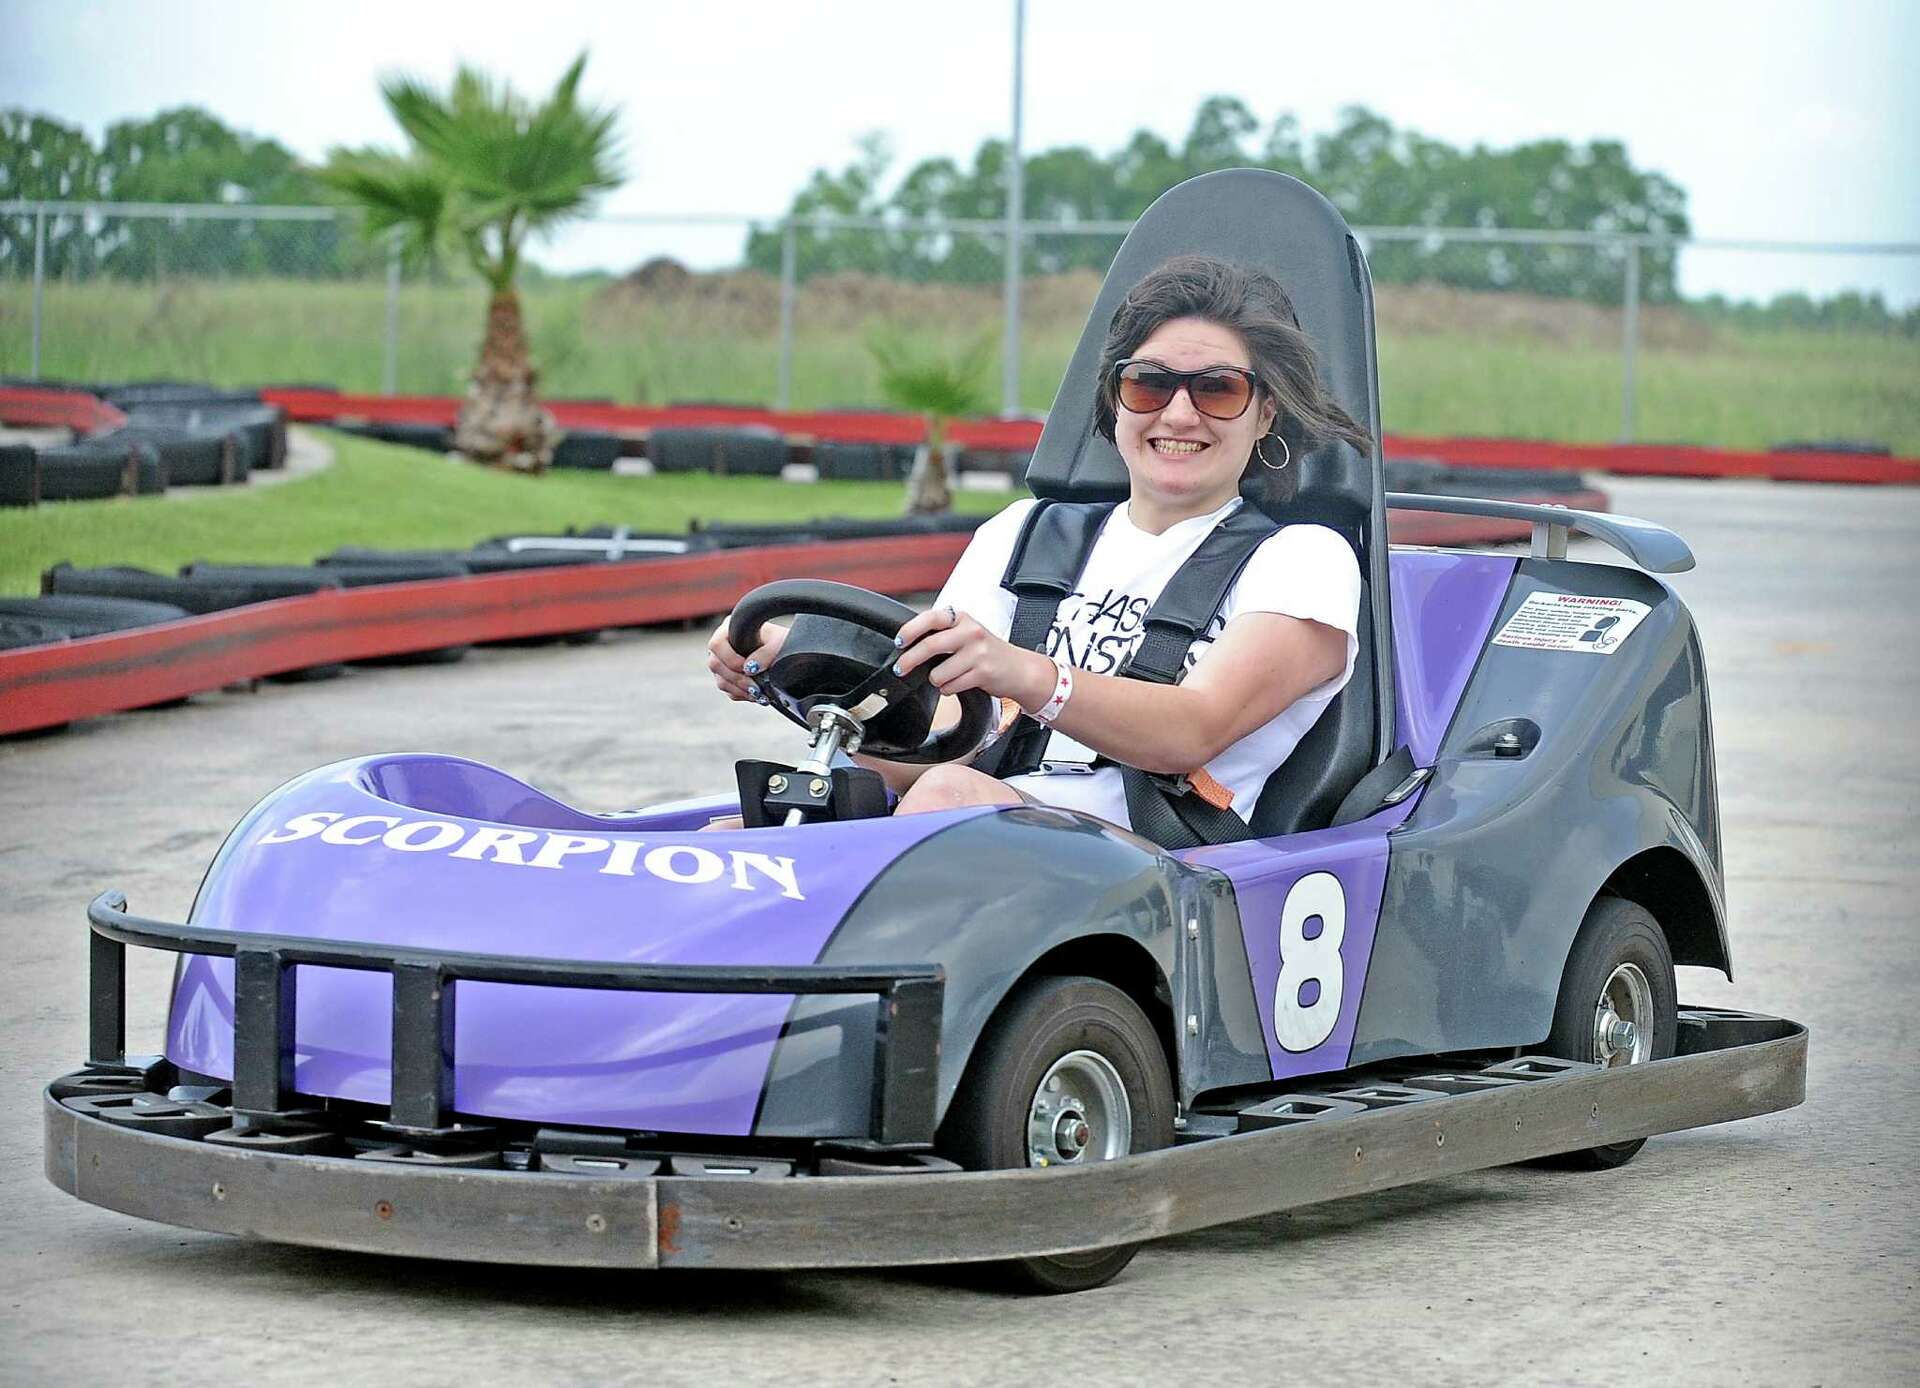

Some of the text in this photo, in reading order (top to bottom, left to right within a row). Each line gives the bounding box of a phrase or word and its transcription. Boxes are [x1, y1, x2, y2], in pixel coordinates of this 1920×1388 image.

[1558, 595, 1623, 606] WARNING!
[256, 811, 806, 901] SCORPION
[1273, 870, 1346, 1054] 8
